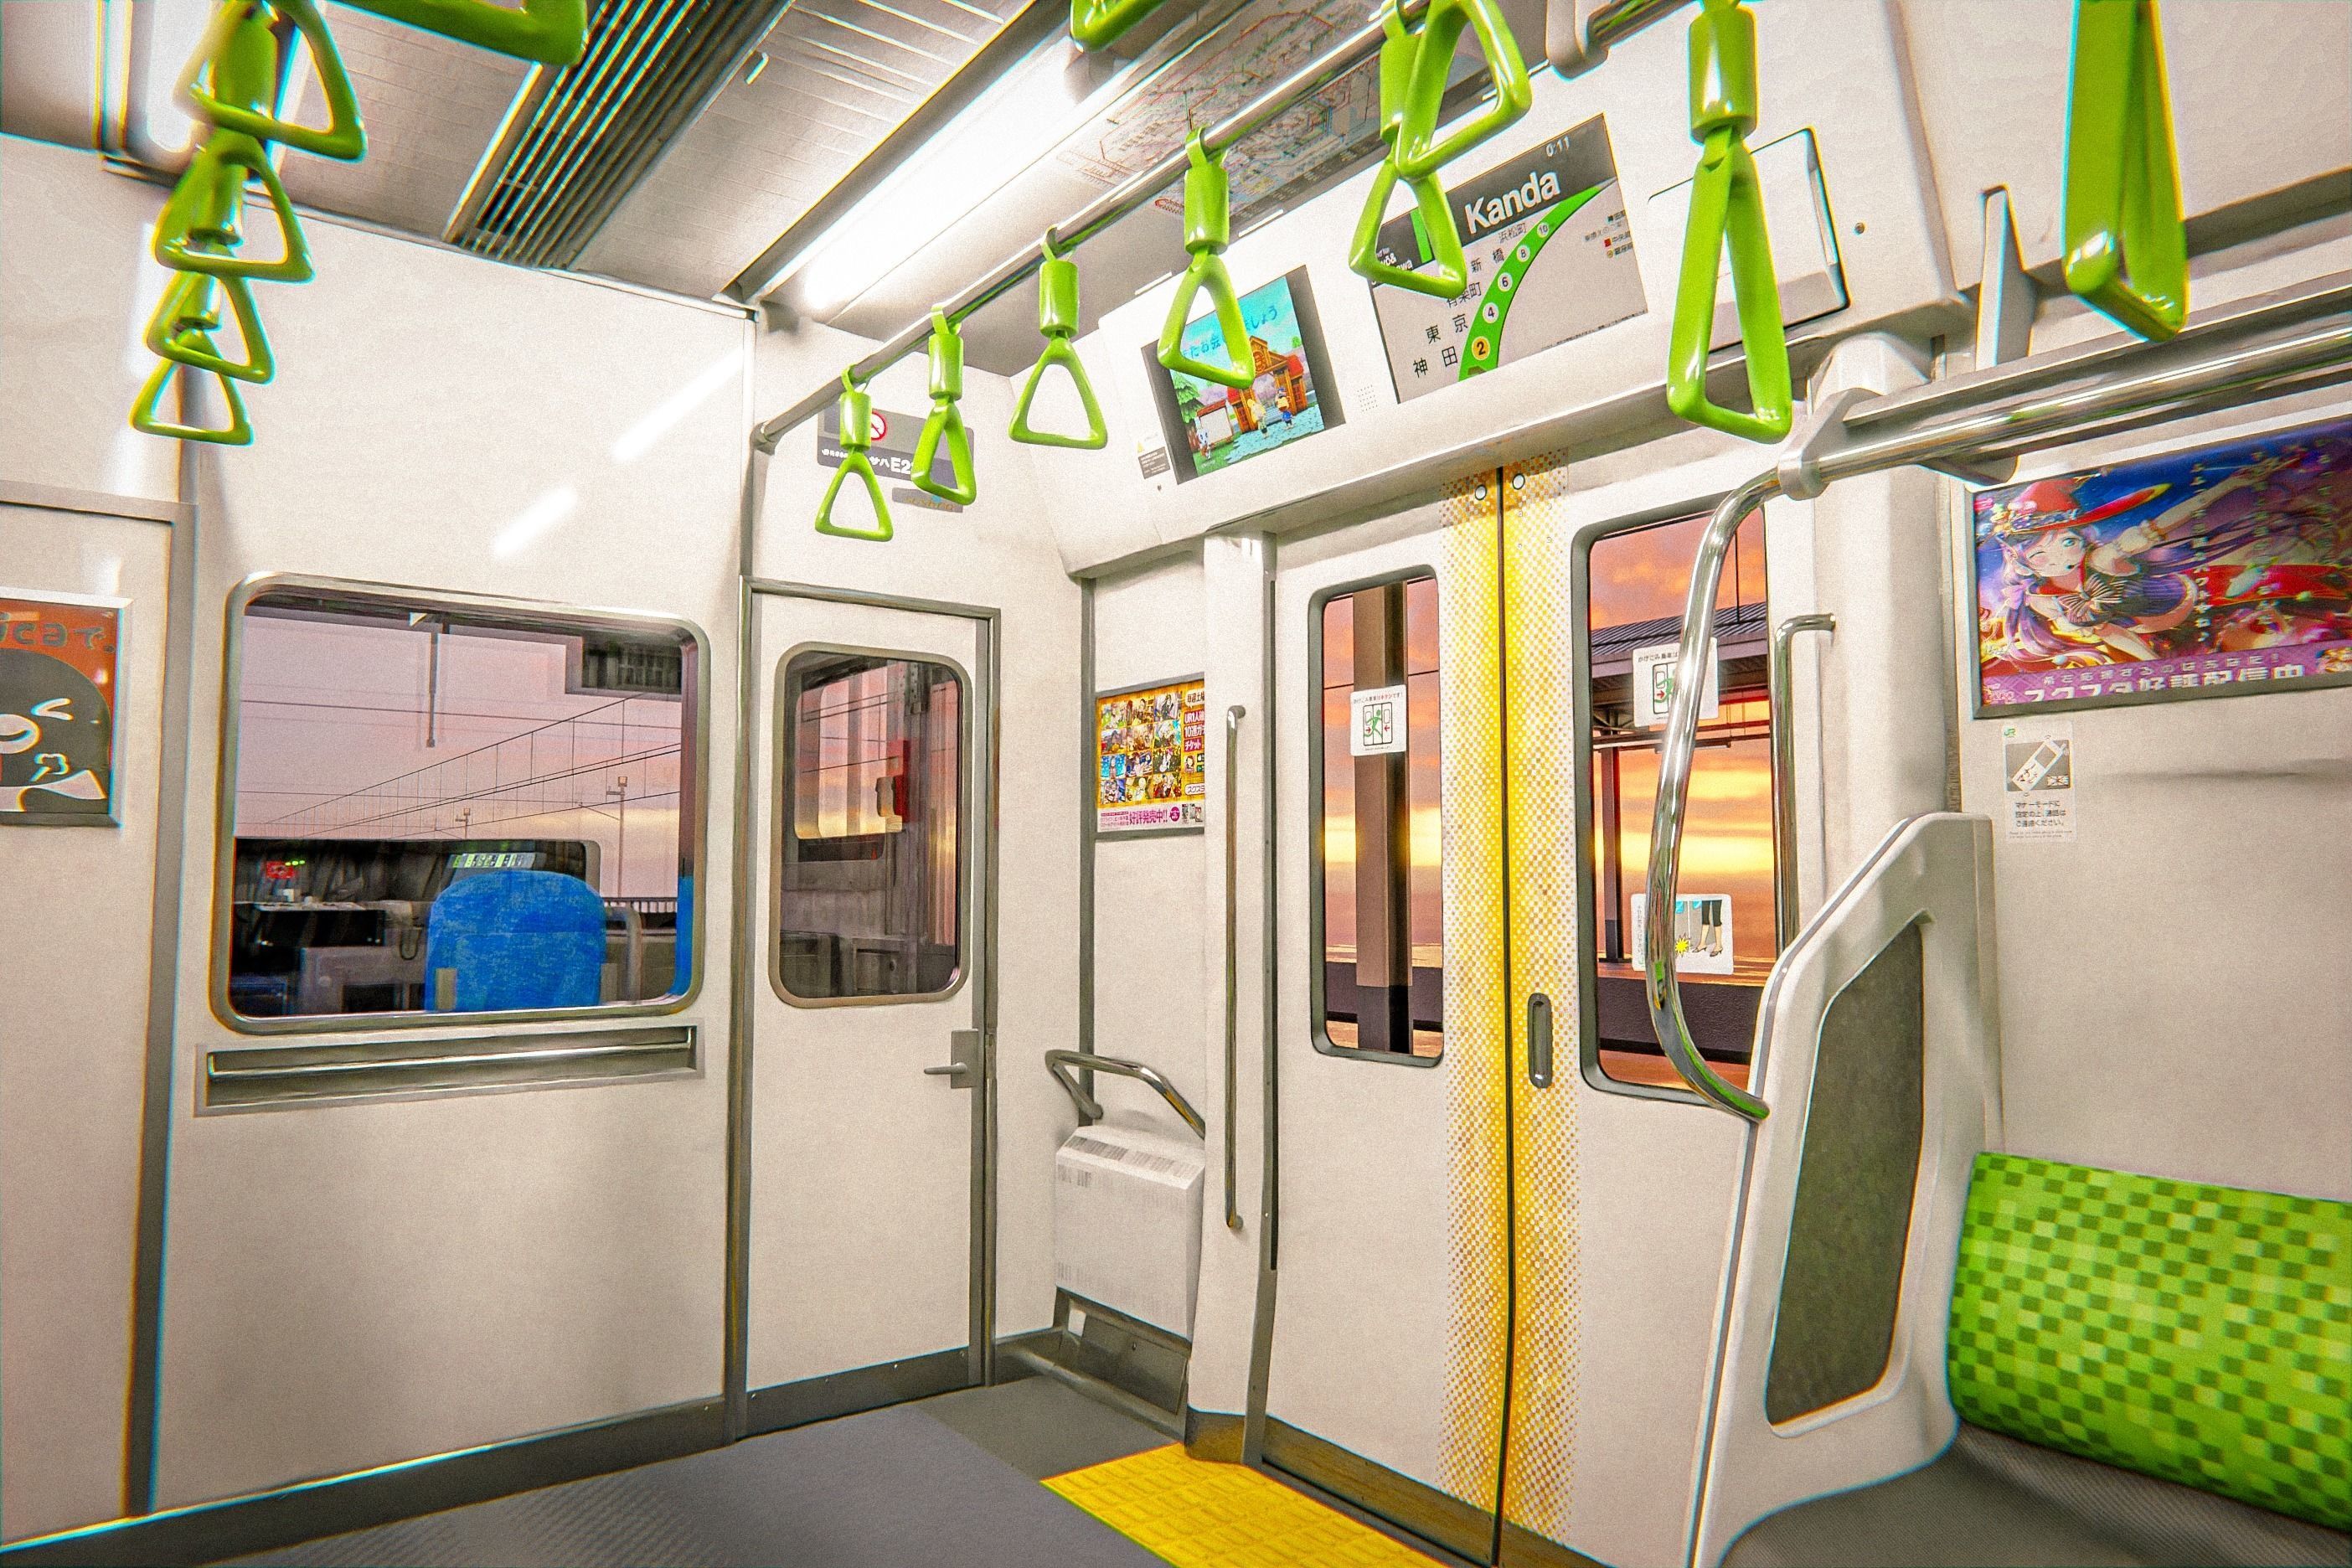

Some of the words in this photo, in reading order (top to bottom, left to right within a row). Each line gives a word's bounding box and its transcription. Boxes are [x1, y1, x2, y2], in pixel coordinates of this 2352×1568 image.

[1545, 136, 1571, 157] 0:11
[1464, 171, 1561, 235] Kanda
[1470, 248, 1505, 273] 新橋
[1488, 307, 1495, 318] 4
[1426, 313, 1468, 344] 東京
[1477, 341, 1486, 355] 2
[1413, 346, 1458, 378] 神田
[869, 456, 914, 475] サハE2
[2004, 728, 2016, 736] JR
